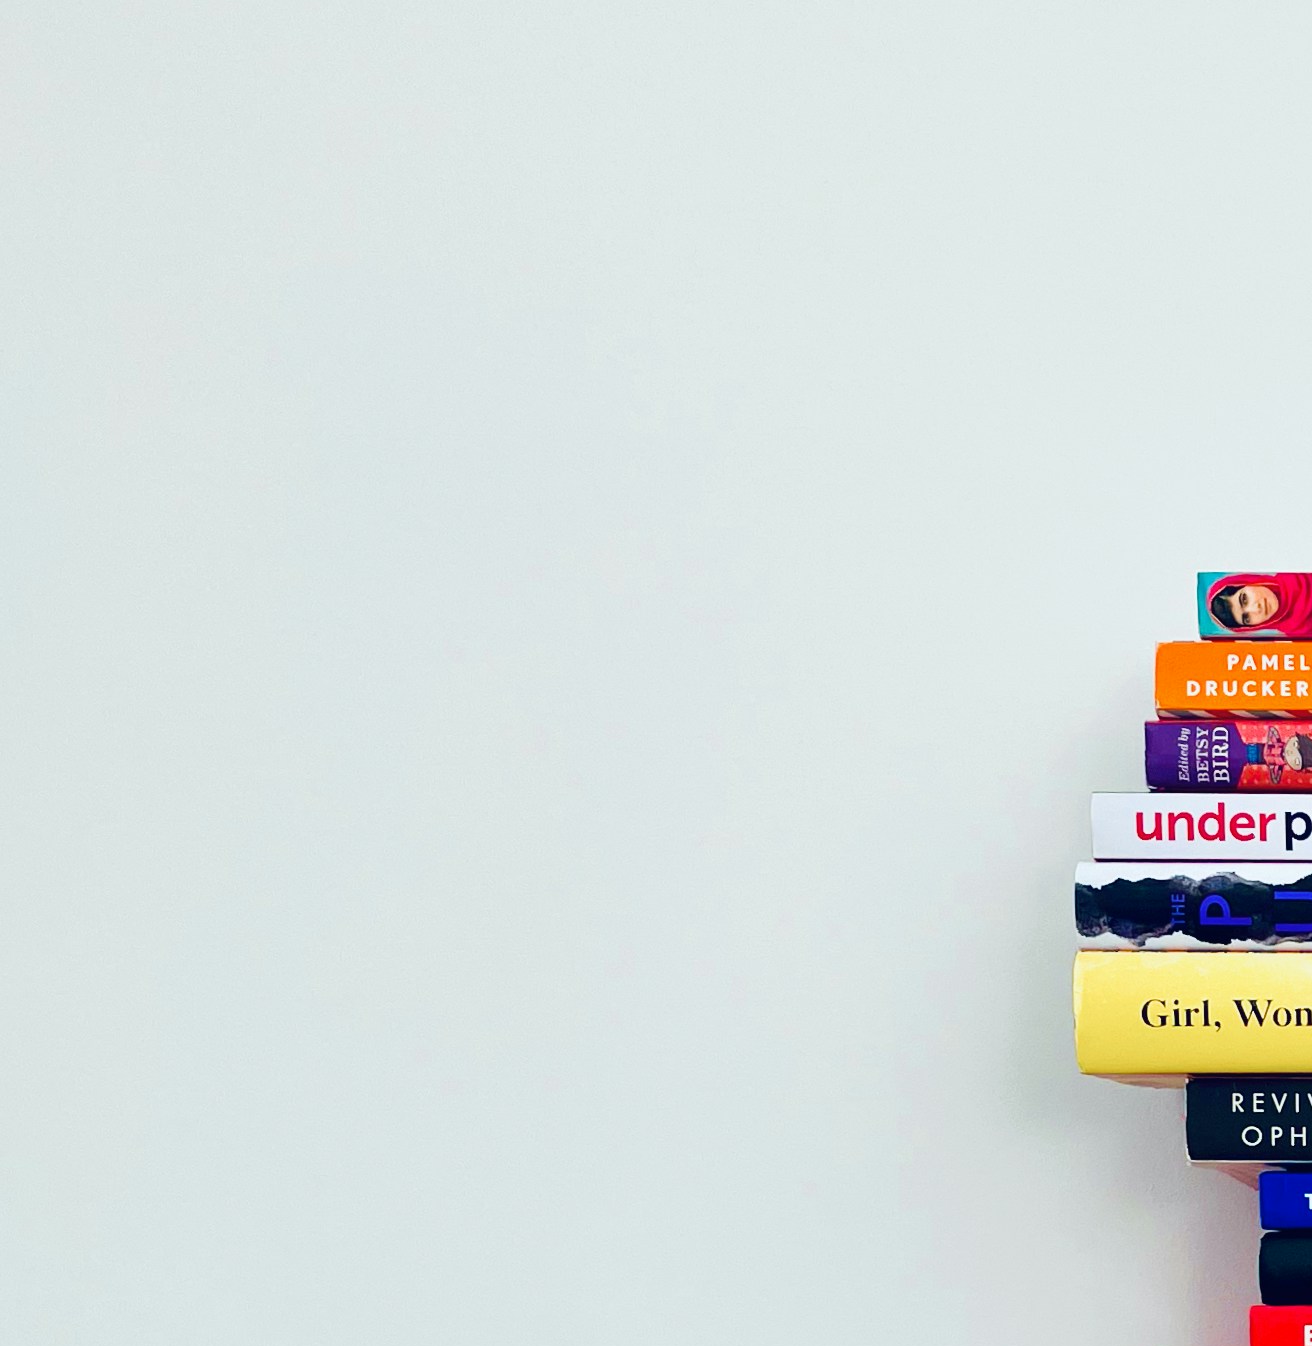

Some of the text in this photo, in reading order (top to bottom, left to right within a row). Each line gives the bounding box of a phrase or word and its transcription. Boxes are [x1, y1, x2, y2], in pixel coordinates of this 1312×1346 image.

[1179, 727, 1192, 782] Edited by
[1196, 726, 1210, 783] BETSY
[1213, 726, 1231, 783] BIRD
[1136, 802, 1276, 842] under
[1171, 893, 1186, 925] THE
[1141, 998, 1222, 1032] Girl,
